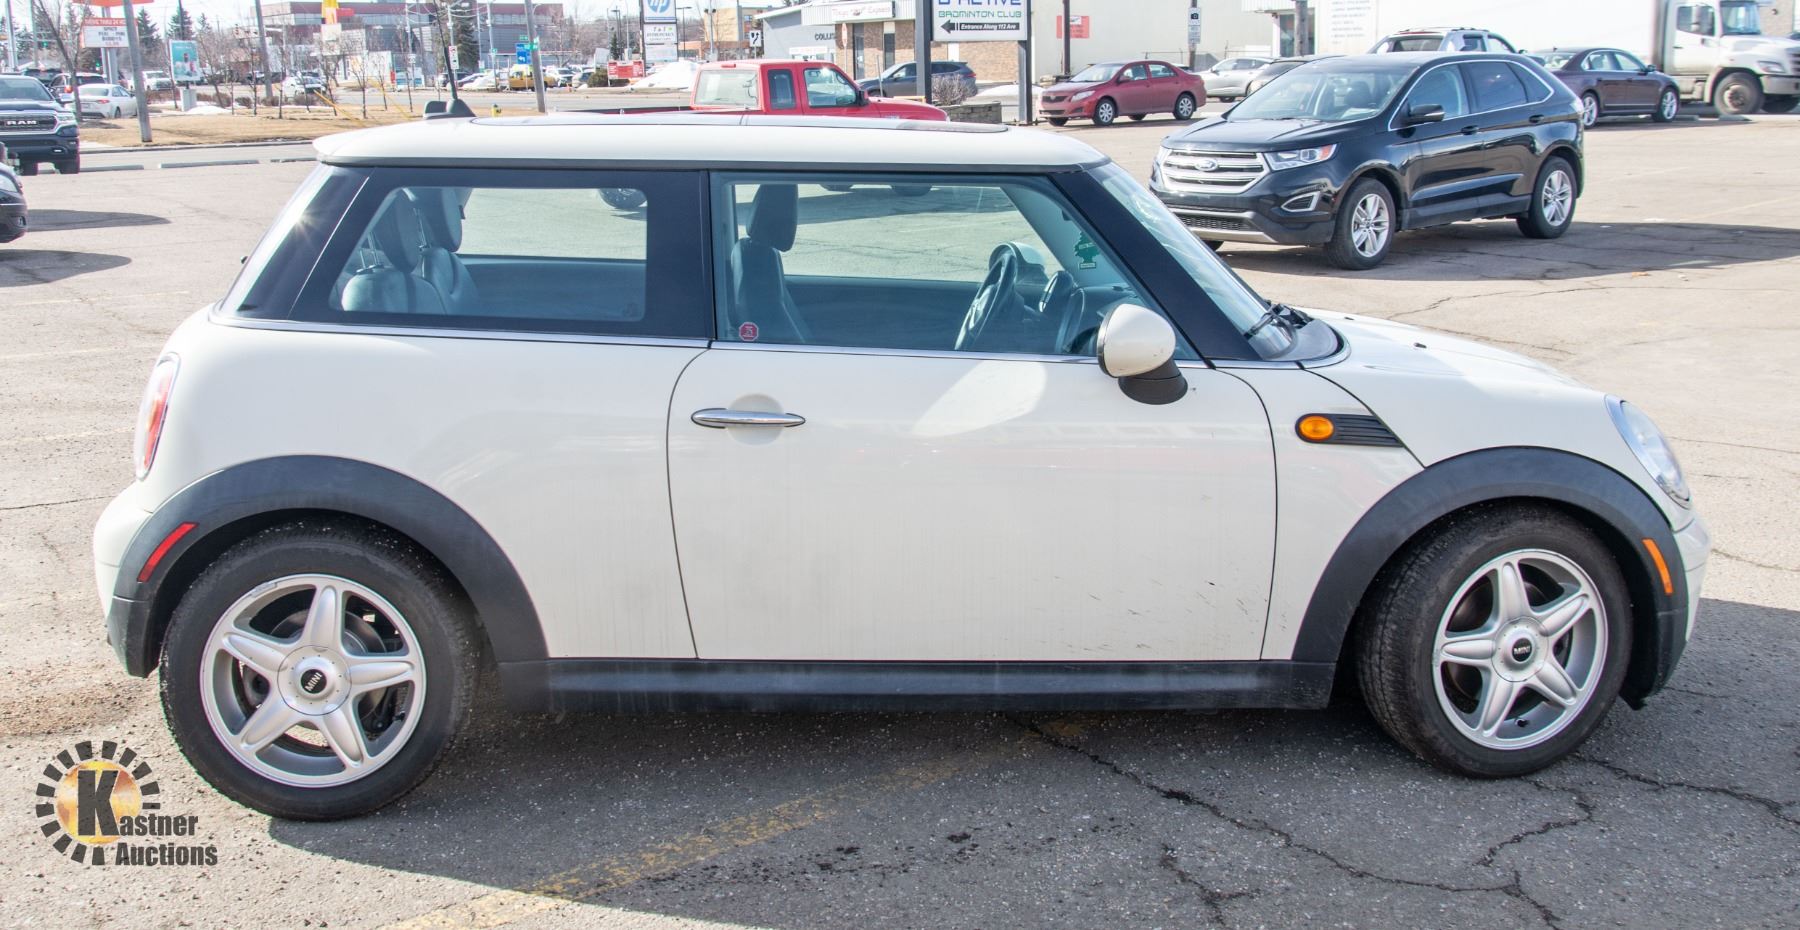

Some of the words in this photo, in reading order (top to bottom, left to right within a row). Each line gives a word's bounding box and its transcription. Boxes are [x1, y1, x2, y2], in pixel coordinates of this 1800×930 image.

[938, 10, 995, 18] BADMINTON
[997, 10, 1022, 18] CLUB
[983, 23, 997, 31] Along
[305, 672, 322, 691] MINI
